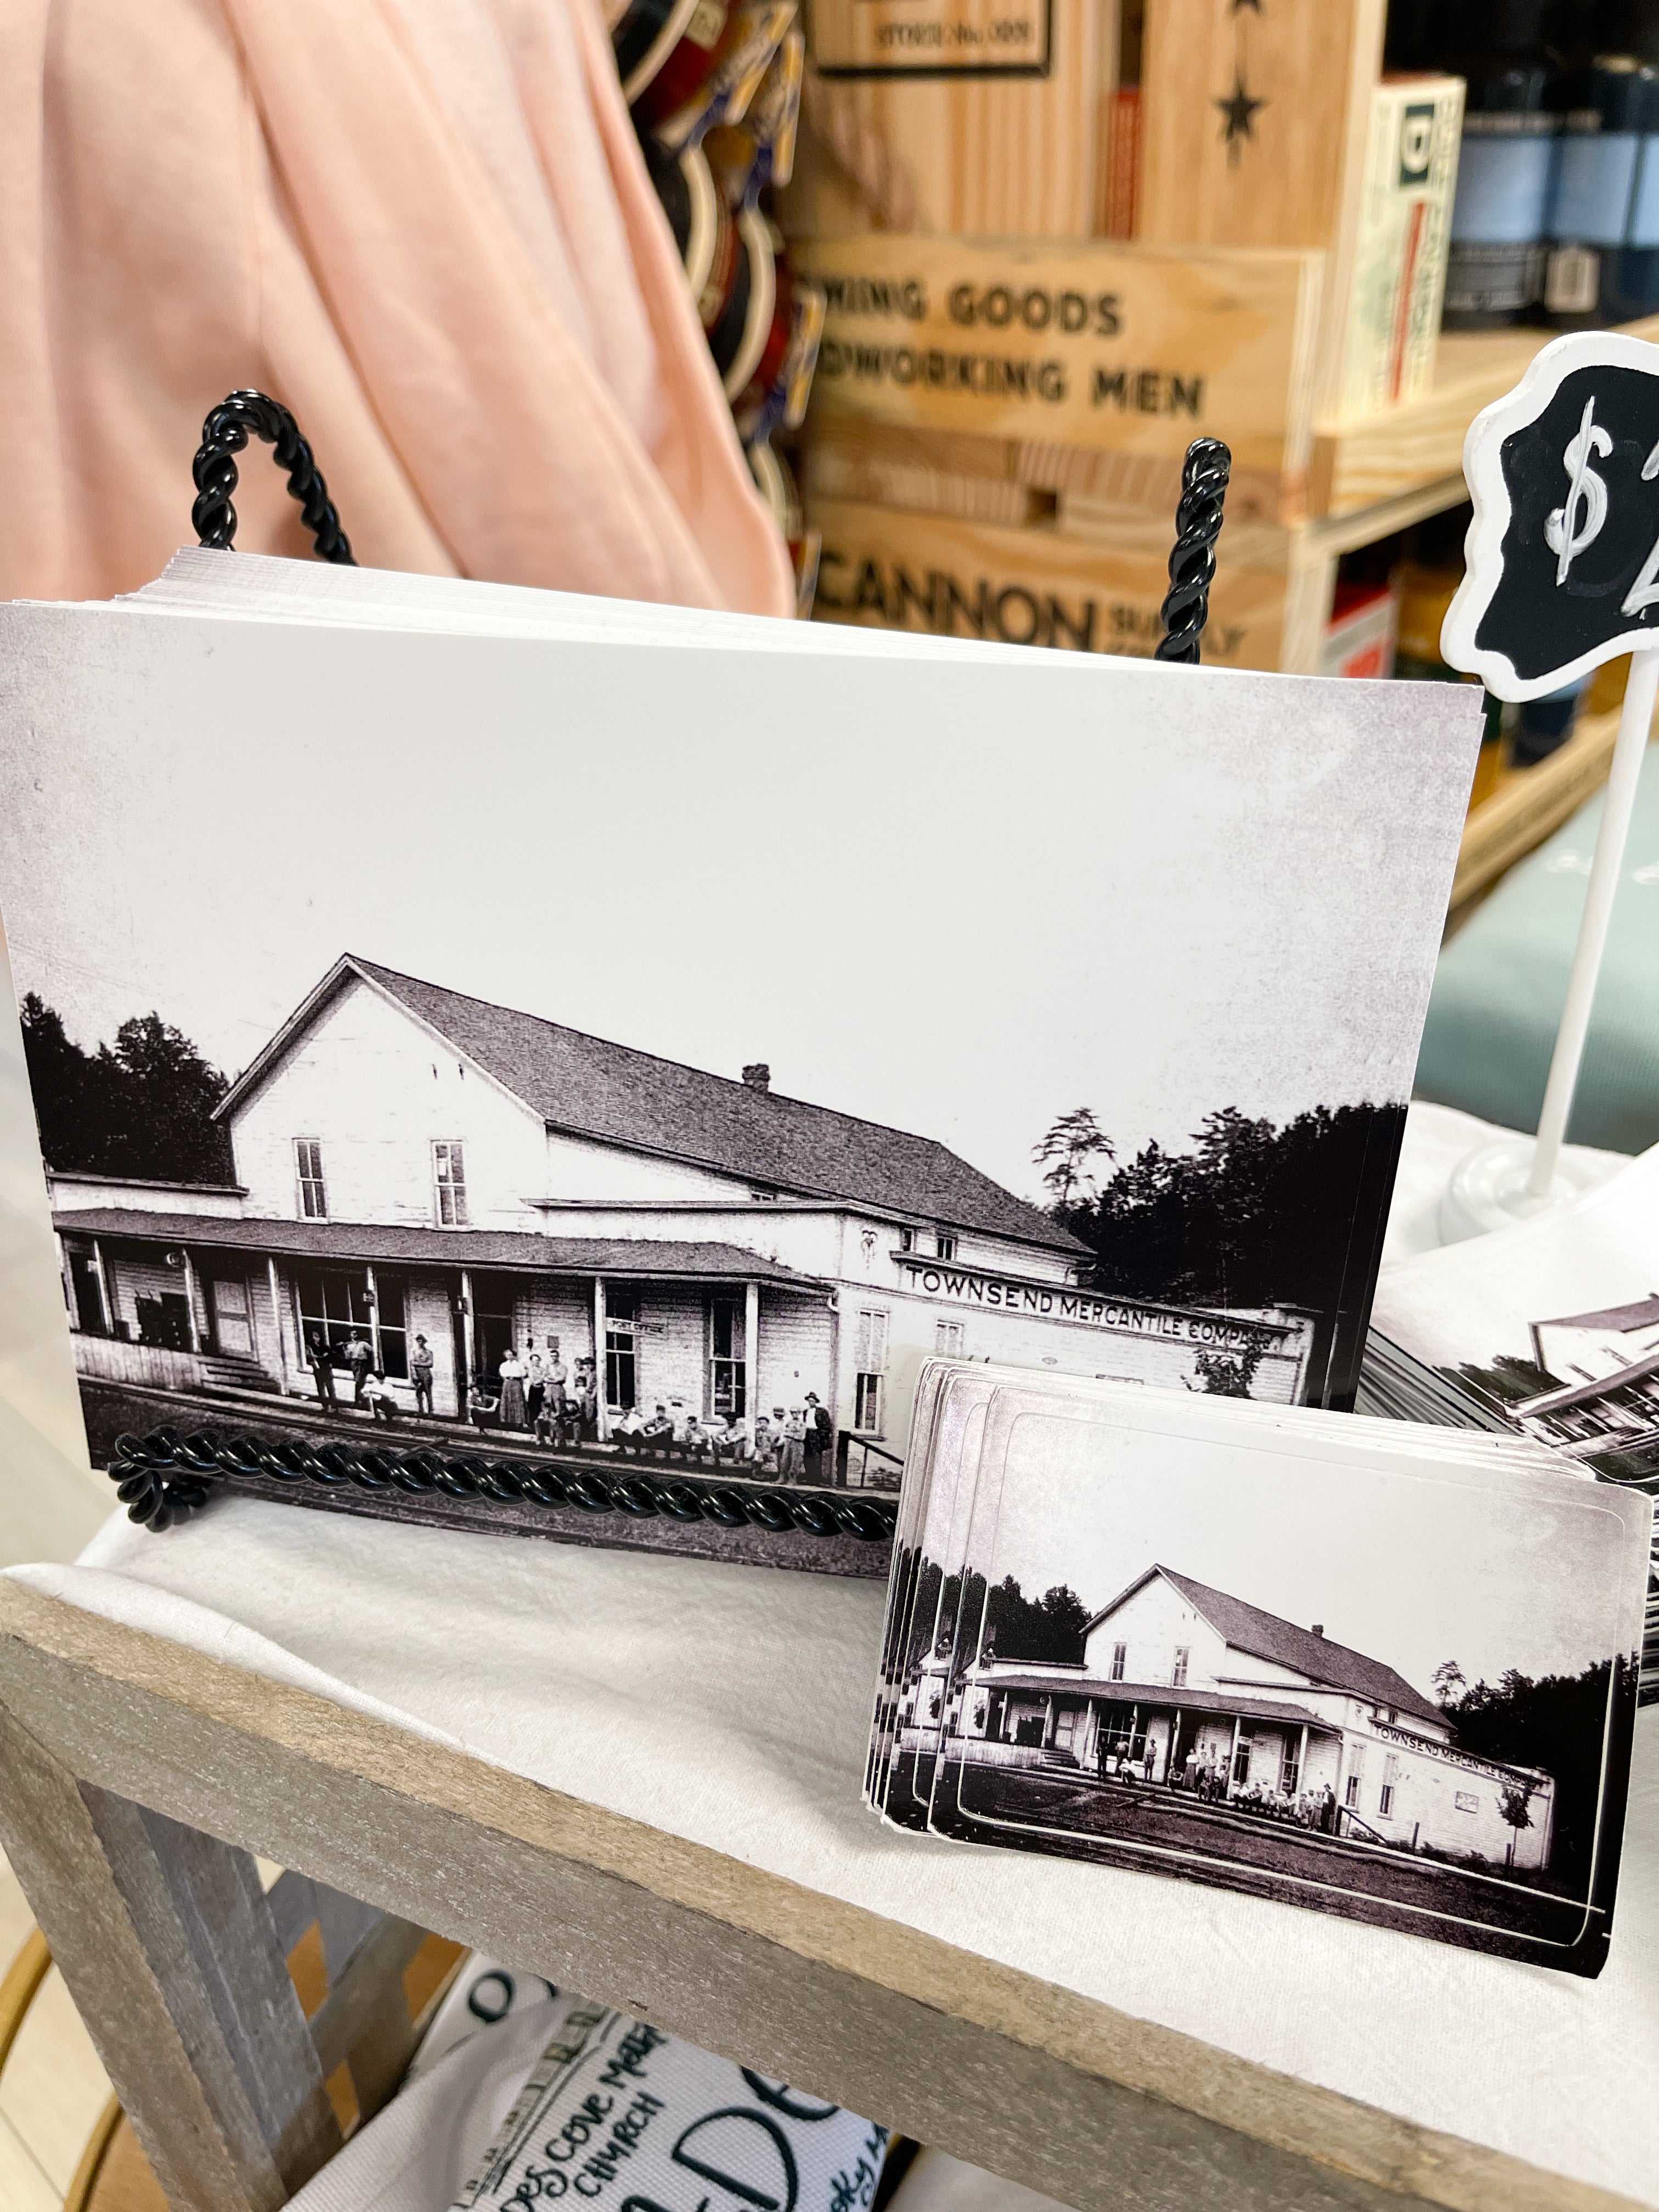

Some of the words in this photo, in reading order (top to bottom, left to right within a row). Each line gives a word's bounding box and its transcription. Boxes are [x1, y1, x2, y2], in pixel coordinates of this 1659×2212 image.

[948, 281, 1122, 336] GOODS
[1089, 366, 1206, 418] MEN
[815, 549, 1096, 652] CANNON
[905, 1263, 1053, 1313] TOWNSEND
[1059, 1295, 1183, 1336] MERCANTILE
[1373, 1722, 1439, 1756] TOWNSEND
